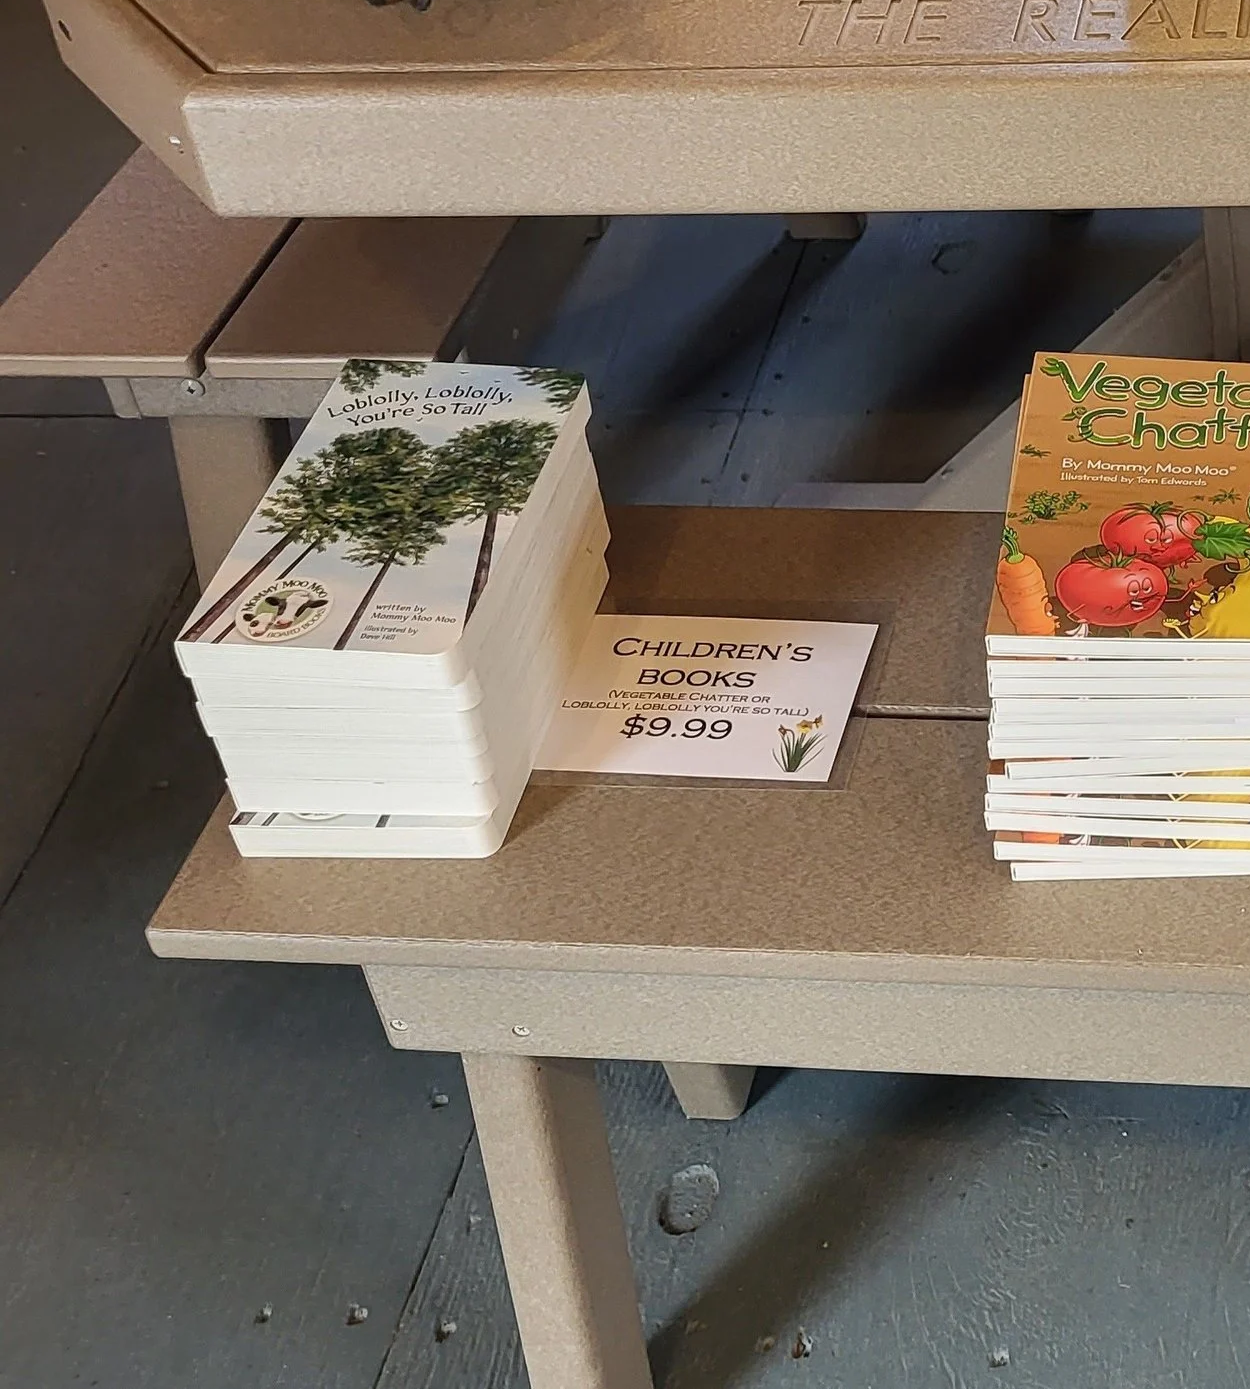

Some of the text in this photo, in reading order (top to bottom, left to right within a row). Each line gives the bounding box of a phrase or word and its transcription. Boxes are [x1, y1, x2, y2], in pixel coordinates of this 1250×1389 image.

[327, 385, 513, 419] Loblolly, Loblolly,
[347, 402, 488, 427] You're So Tall
[1062, 457, 1083, 470] By
[1087, 459, 1152, 475] Mommy
[1156, 463, 1192, 474] Moo
[1060, 472, 1207, 487] Illustrated by Tom Edwards
[241, 582, 279, 612] MOMMY
[282, 580, 308, 590] MOO
[370, 612, 457, 624] Mommy Moo Moo
[375, 603, 427, 615] written by
[360, 632, 381, 640] Dave
[364, 625, 419, 636] illustrated by
[612, 637, 815, 662] CHILDREN'S
[636, 668, 757, 688] BOOKS
[608, 689, 771, 704] (VEGETABLE CHATTER OR
[561, 699, 809, 717] LOBLOLLY, LOBLOLLY YOU'RE SO TALL)
[619, 713, 734, 740] $9.99
